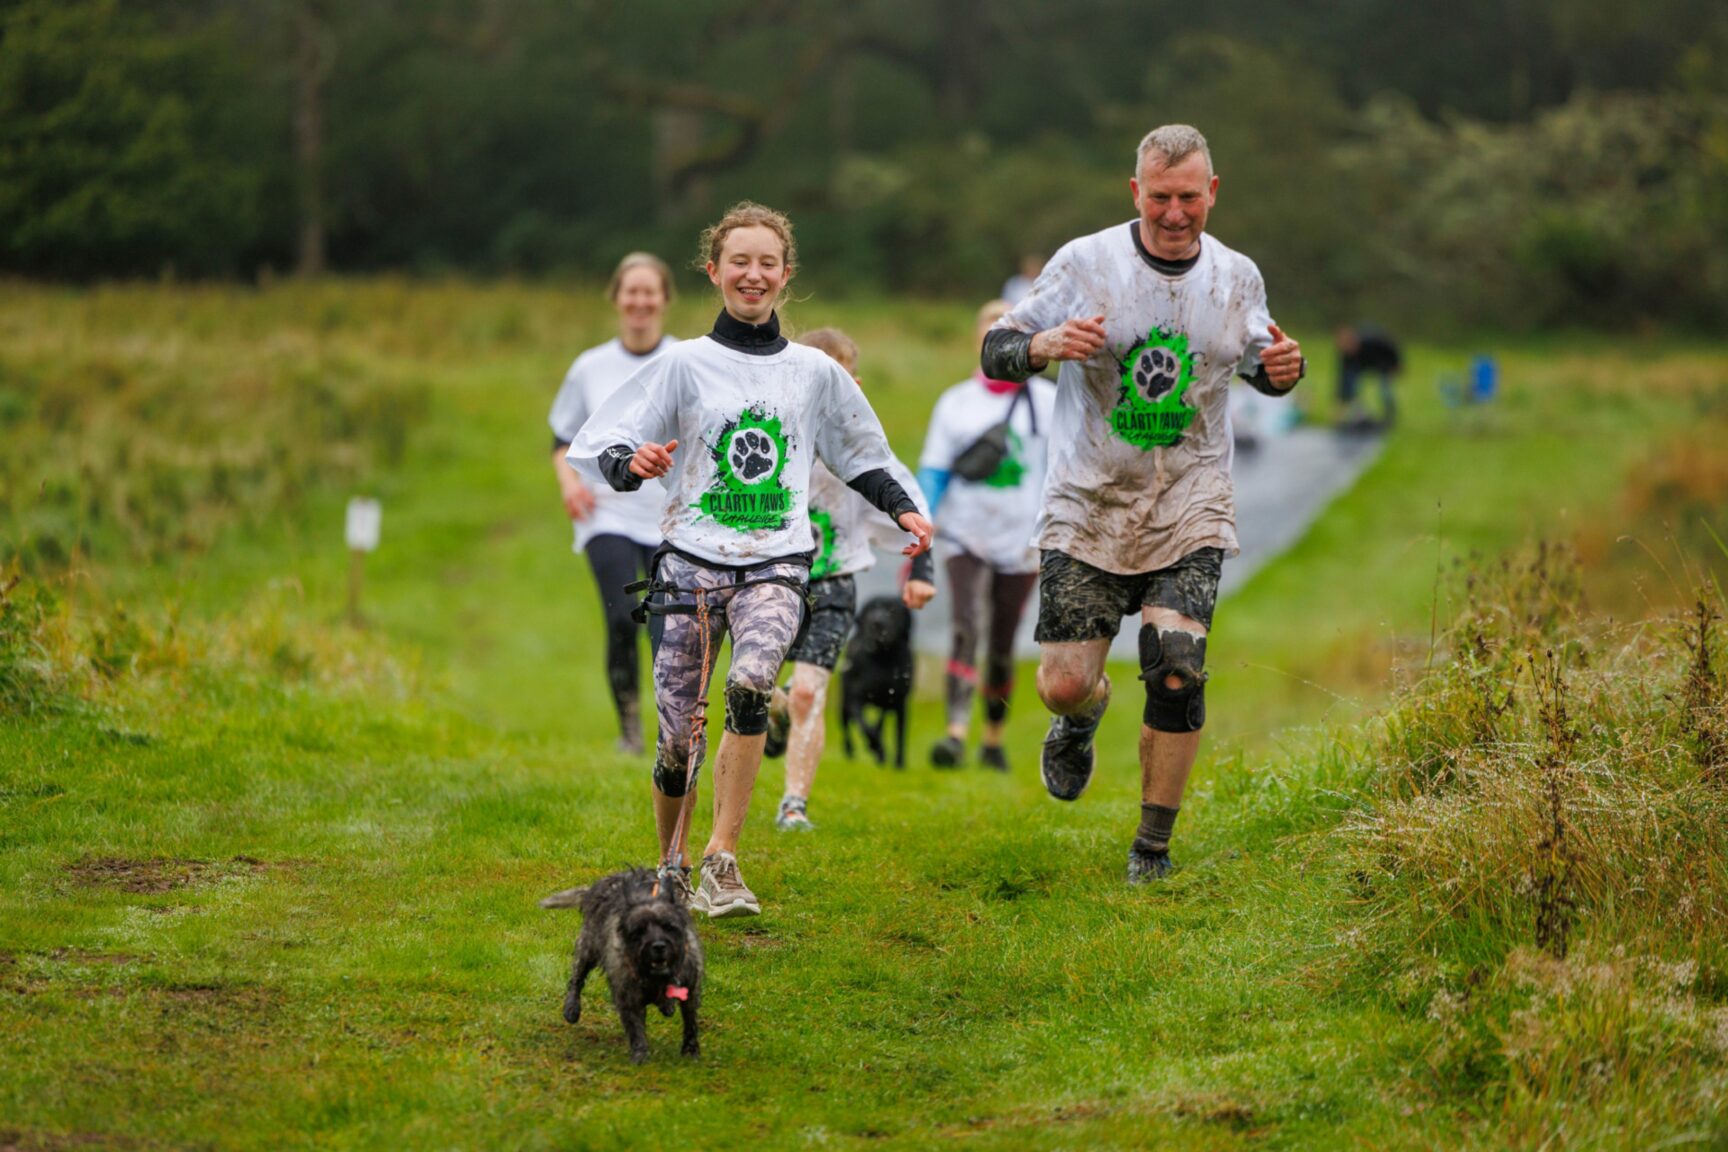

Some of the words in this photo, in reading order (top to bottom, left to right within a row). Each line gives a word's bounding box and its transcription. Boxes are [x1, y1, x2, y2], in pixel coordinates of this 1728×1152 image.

[1117, 411, 1157, 430] CLARTY
[709, 494, 756, 512] CLARTY
[760, 493, 785, 511] PAWS
[721, 512, 778, 523] CHALLENGE
